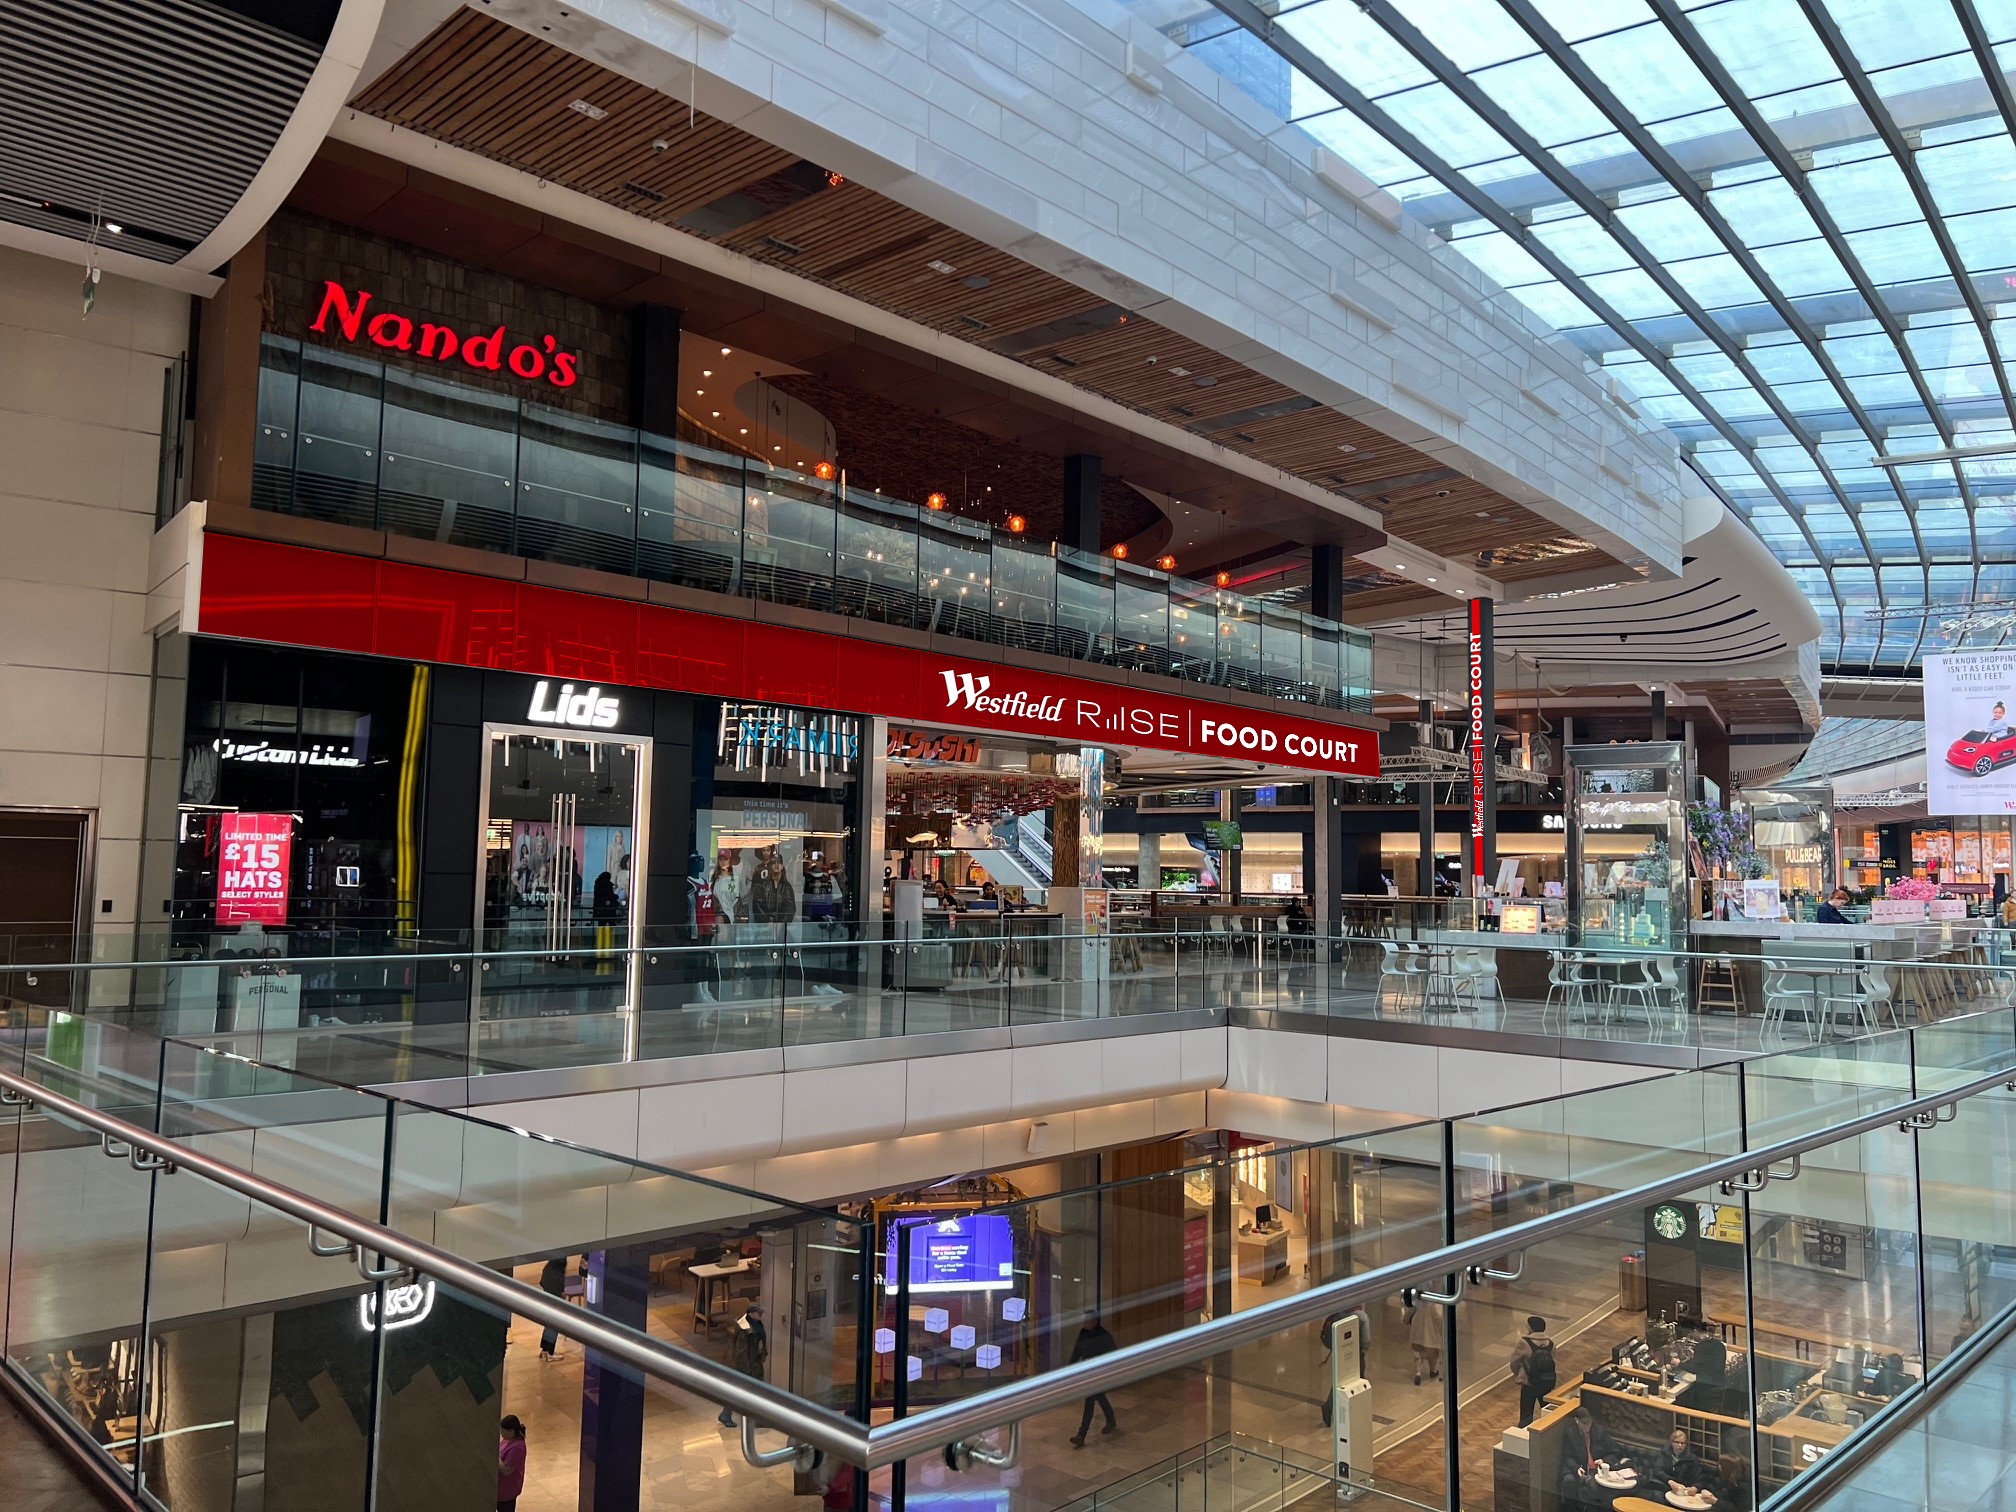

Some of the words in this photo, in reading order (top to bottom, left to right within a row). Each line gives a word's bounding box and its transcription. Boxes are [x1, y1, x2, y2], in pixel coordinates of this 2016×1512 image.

[309, 280, 576, 387] Nando's
[1469, 632, 1482, 691] COURT
[1942, 657, 1953, 665] WE
[1955, 656, 1977, 665] KNOW
[1947, 665, 1967, 673] ISN'T
[1982, 664, 2000, 672] EASY
[2003, 663, 2013, 671] ON
[1956, 673, 1982, 681] LITTLE
[1984, 672, 2005, 680] FEET.
[527, 680, 620, 728] Lids
[938, 669, 1068, 722] Westfield
[1201, 719, 1278, 752] FOOD
[1284, 733, 1359, 763] COURT
[1472, 694, 1483, 740] FOOD
[743, 800, 758, 808] this
[759, 801, 776, 809] time
[777, 801, 789, 809] it's
[743, 810, 809, 829] PERSONAL
[1471, 799, 1484, 838] Westfield
[225, 832, 263, 841] LIMITED
[265, 833, 288, 842] TIME
[224, 843, 280, 869] £15
[224, 870, 283, 889] HATS
[221, 891, 252, 899] SELECT
[253, 891, 284, 899] STYLES
[249, 985, 289, 996] PERSONAL
